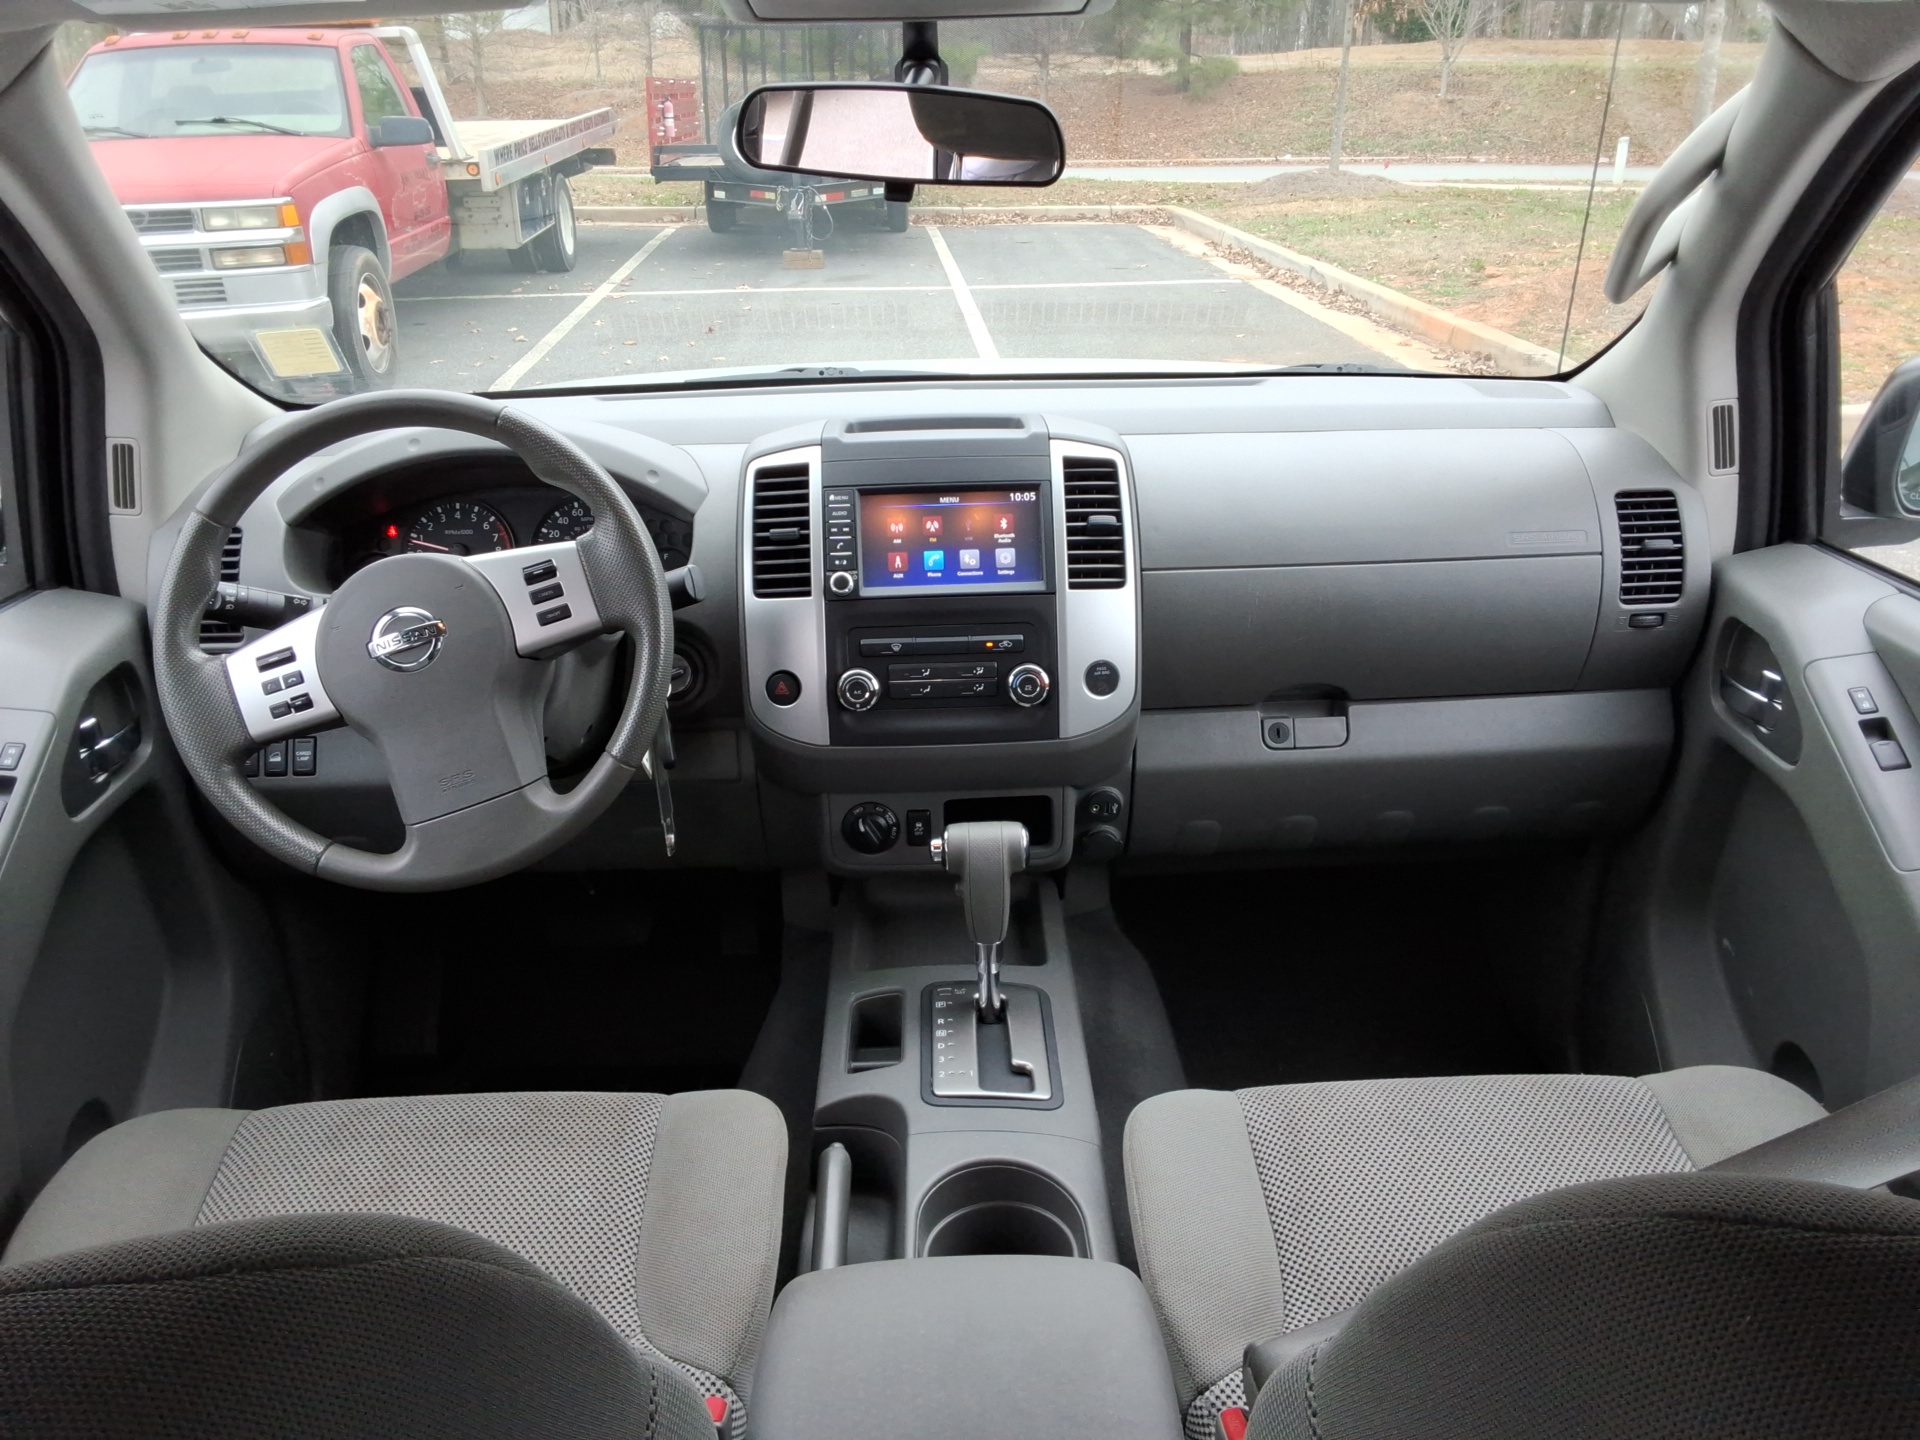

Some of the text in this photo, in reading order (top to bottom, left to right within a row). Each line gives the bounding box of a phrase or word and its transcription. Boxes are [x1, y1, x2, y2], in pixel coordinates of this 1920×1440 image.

[939, 496, 960, 504] MENU
[1009, 492, 1036, 502] 10:05
[454, 511, 461, 519] 4
[571, 508, 584, 517] 60
[440, 514, 446, 522] 3
[471, 513, 477, 522] 5
[557, 516, 569, 525] 40
[427, 522, 434, 531] 2
[483, 522, 490, 530] 6
[419, 534, 424, 542] 1
[492, 533, 499, 542] 7
[548, 530, 560, 538] 20
[375, 626, 437, 651] NISSAN
[938, 1070, 946, 1078] 2
